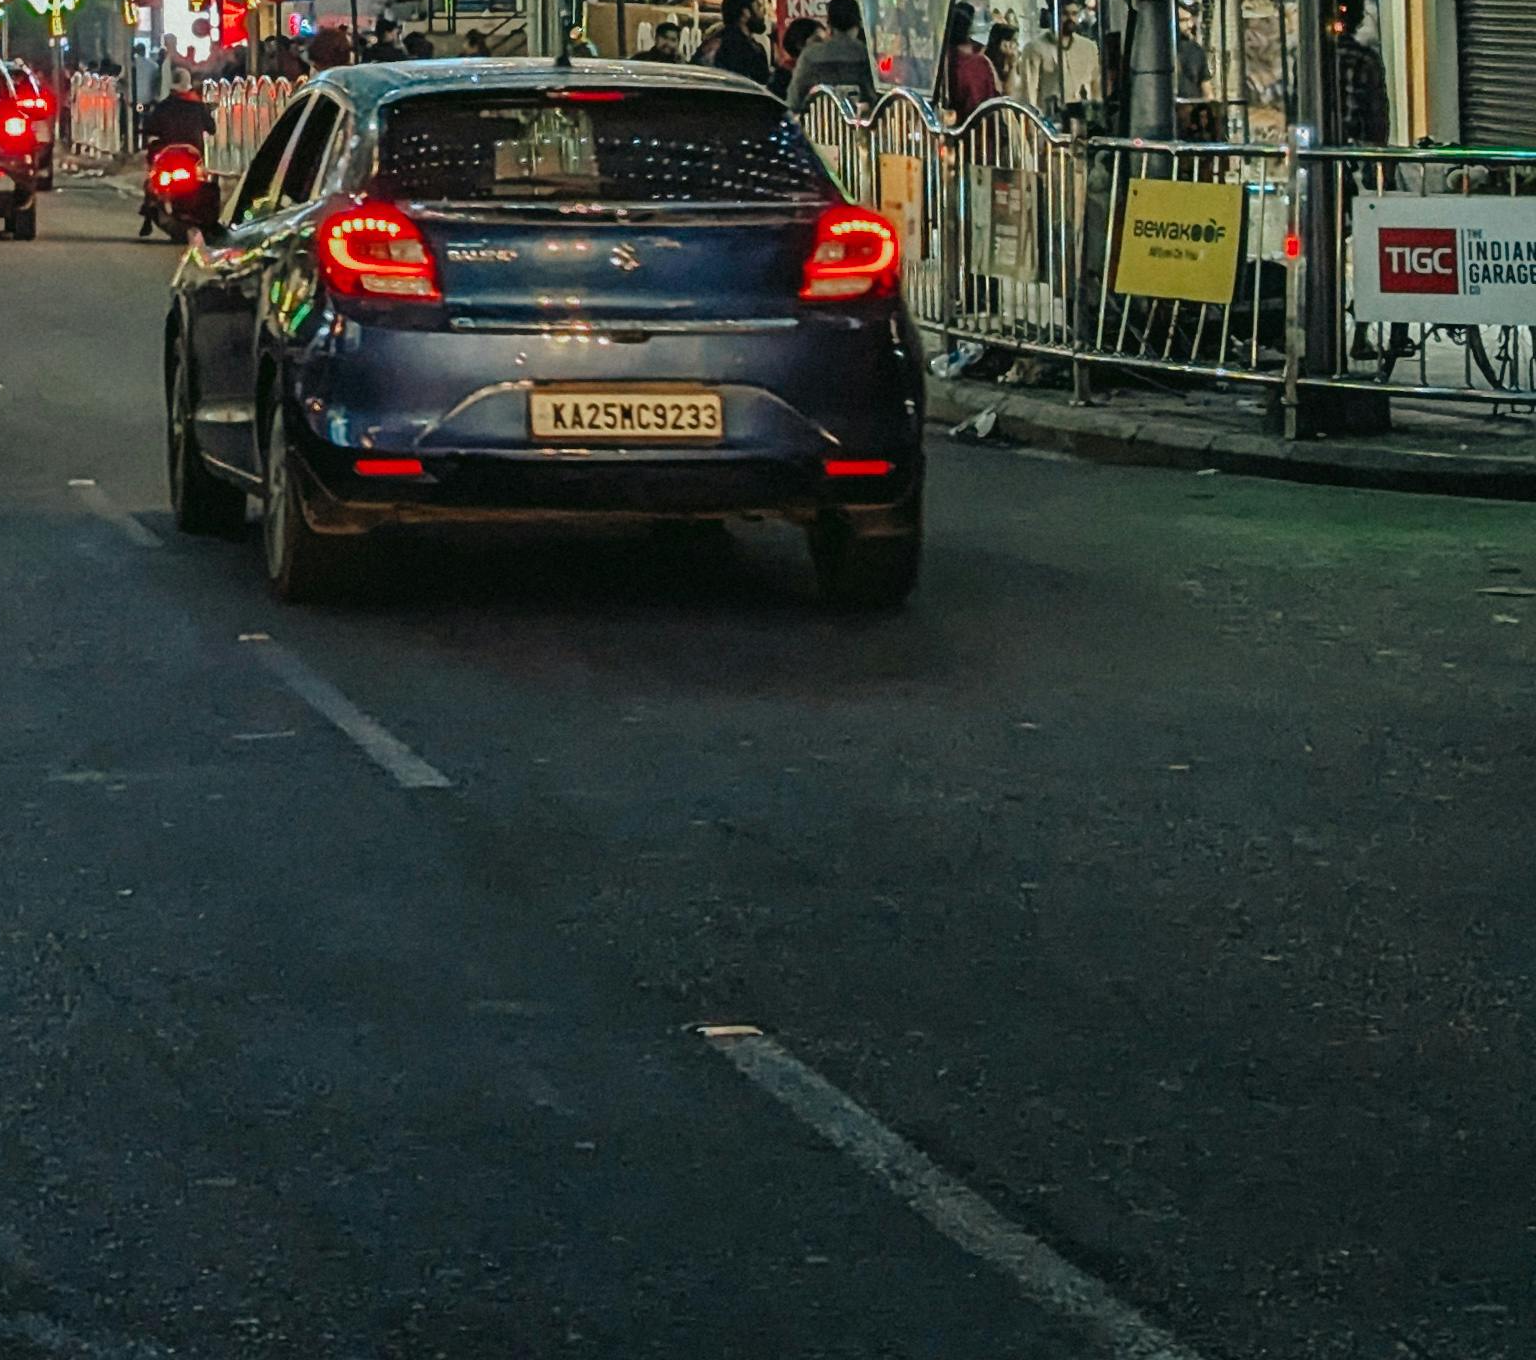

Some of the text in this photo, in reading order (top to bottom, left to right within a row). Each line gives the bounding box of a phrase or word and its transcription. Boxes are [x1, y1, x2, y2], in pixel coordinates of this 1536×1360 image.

[1385, 245, 1453, 274] TIGC
[1468, 241, 1536, 262] INDIAN
[553, 402, 718, 431] KA25MC9233
